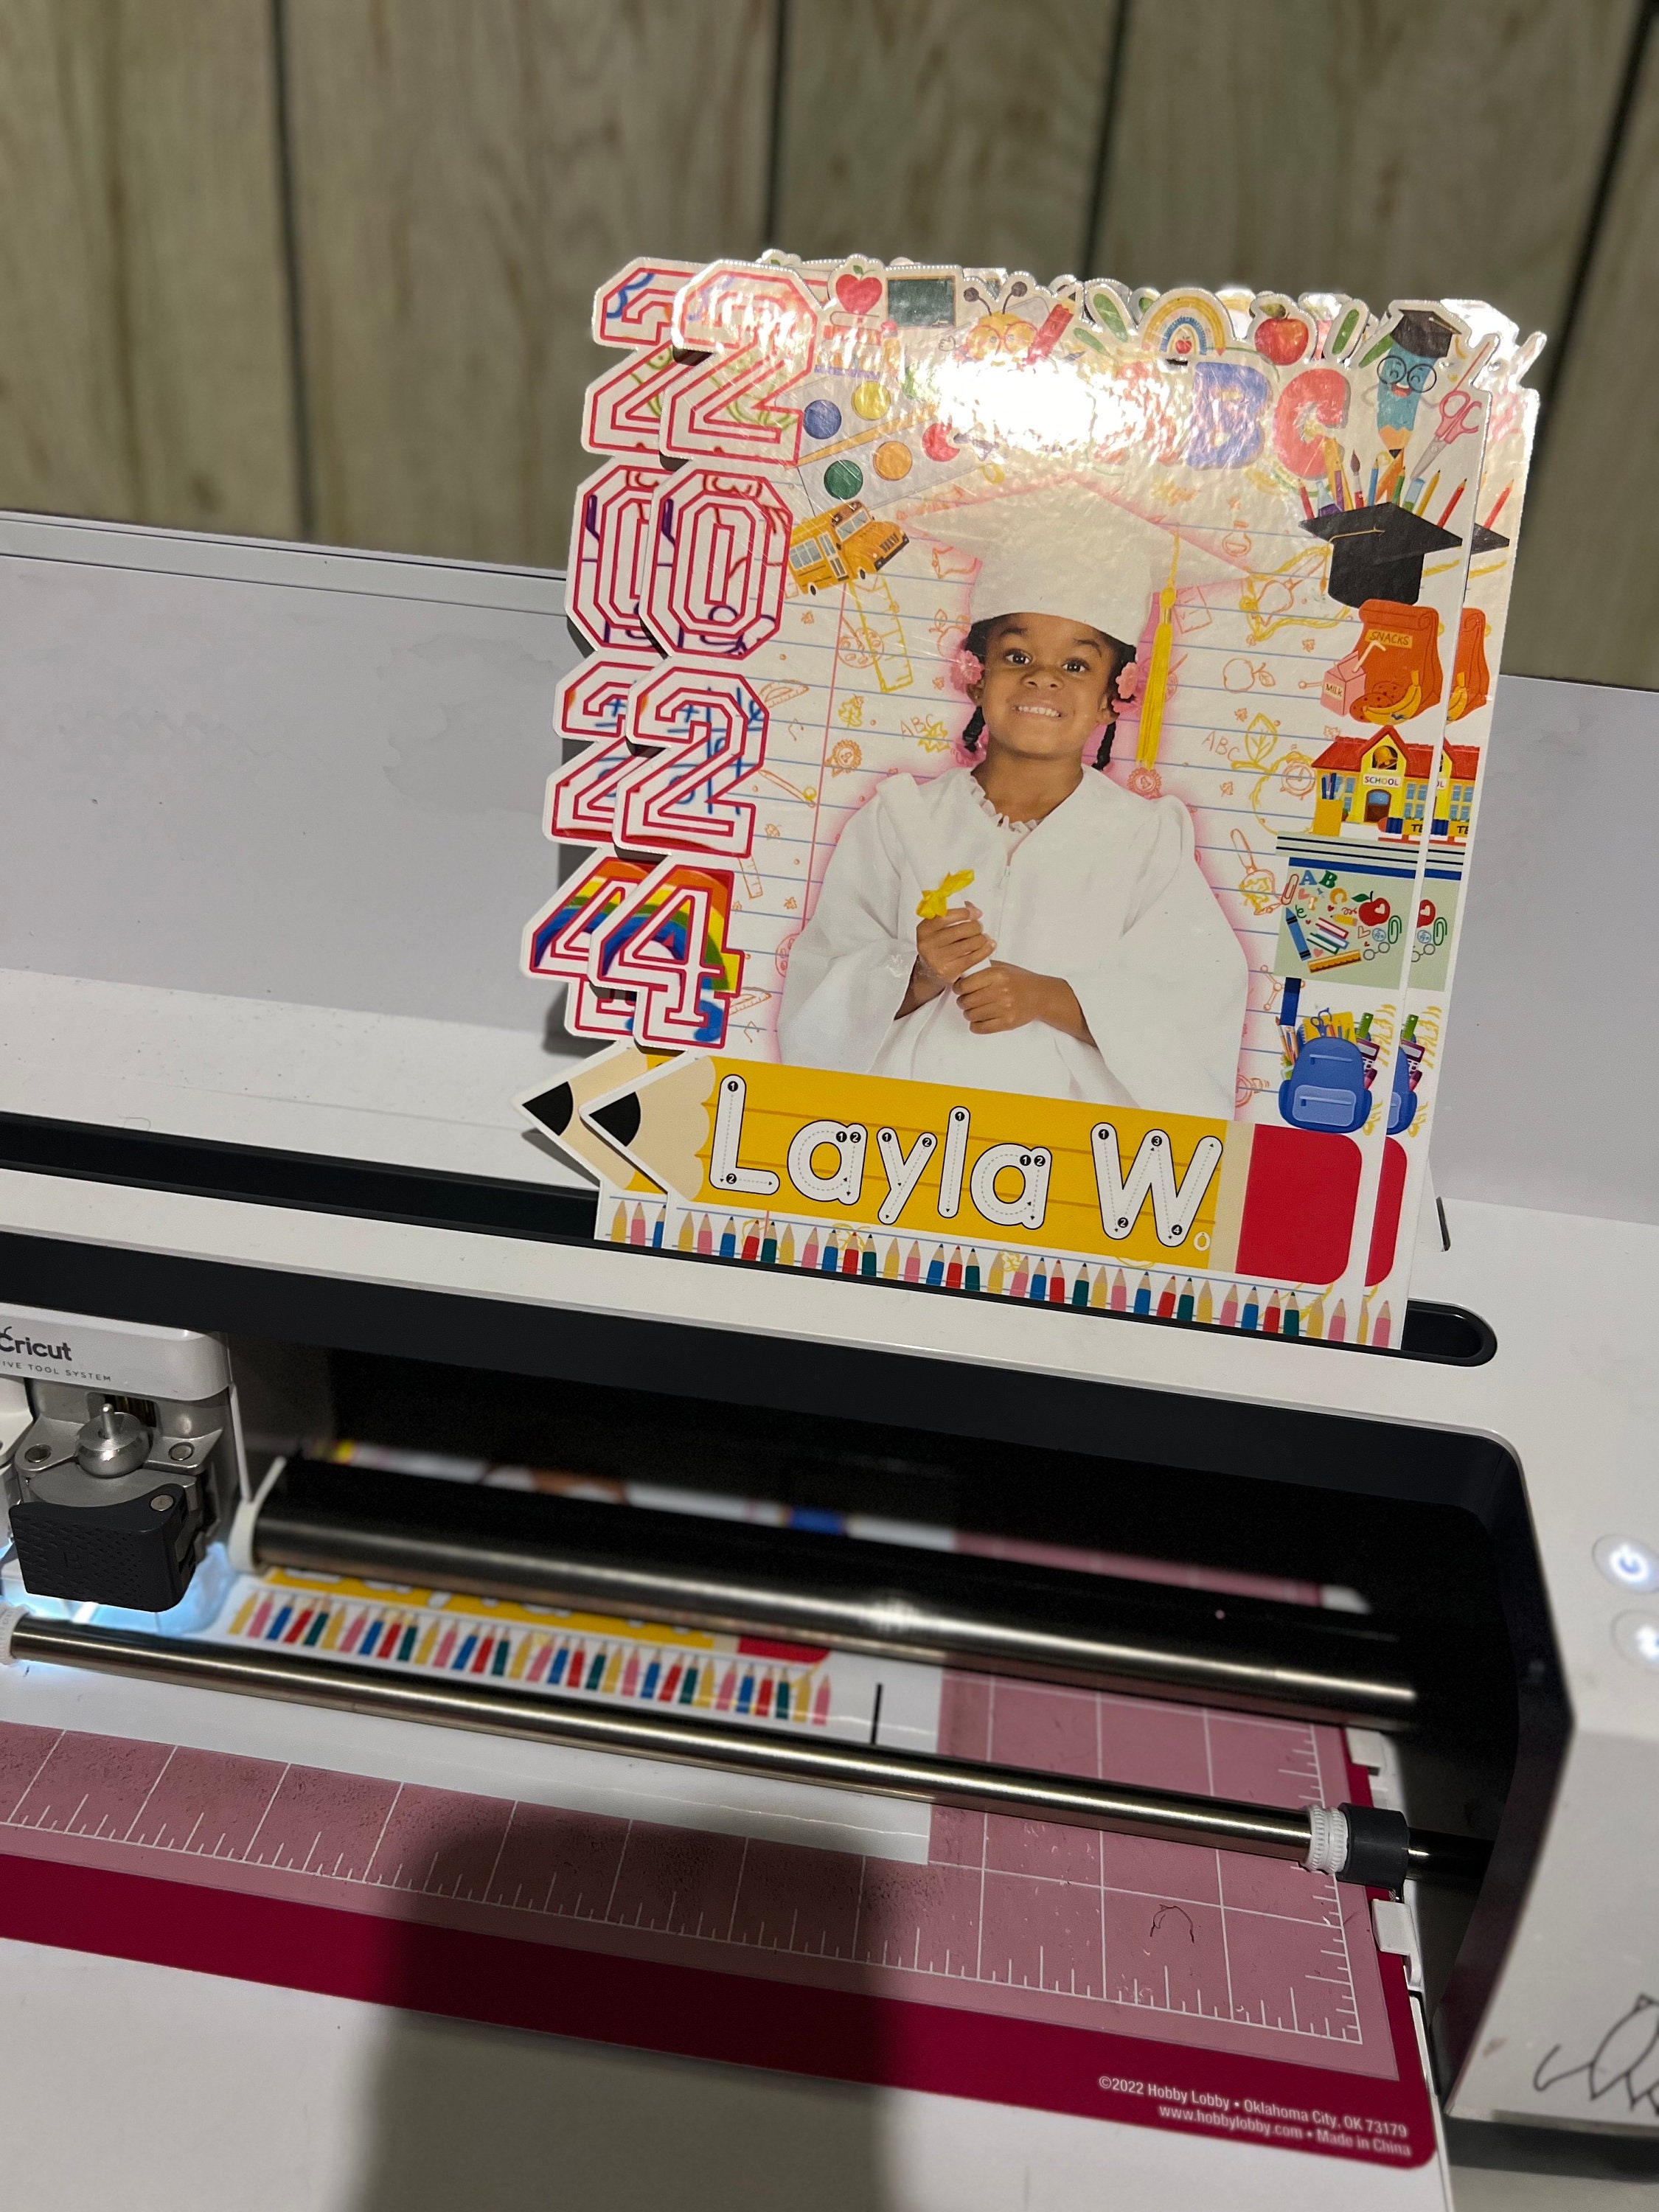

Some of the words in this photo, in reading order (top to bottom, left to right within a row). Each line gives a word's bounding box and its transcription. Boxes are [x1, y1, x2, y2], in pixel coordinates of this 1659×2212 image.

[1368, 631, 1410, 646] SNACKS
[1326, 684, 1343, 697] MILK
[1364, 776, 1399, 786] SCHOOL
[709, 1074, 1052, 1229] Layla
[0, 1326, 72, 1361] Cricut
[28, 1364, 59, 1374] TOOL
[66, 1369, 111, 1382] SYSTEM
[1099, 2076, 1144, 2094] ©2022
[1148, 2084, 1187, 2104] Hobby
[1192, 2090, 1230, 2111] Lobby
[1244, 2099, 1309, 2122] Oklahoma
[1312, 2110, 1341, 2129] City,
[1344, 2115, 1363, 2131] OK
[1366, 2119, 1408, 2138] 73179
[1159, 2106, 1303, 2138] www.hobbylobby.com
[1316, 2128, 1354, 2147] Made
[1357, 2135, 1370, 2149] in
[1372, 2138, 1411, 2157] China
